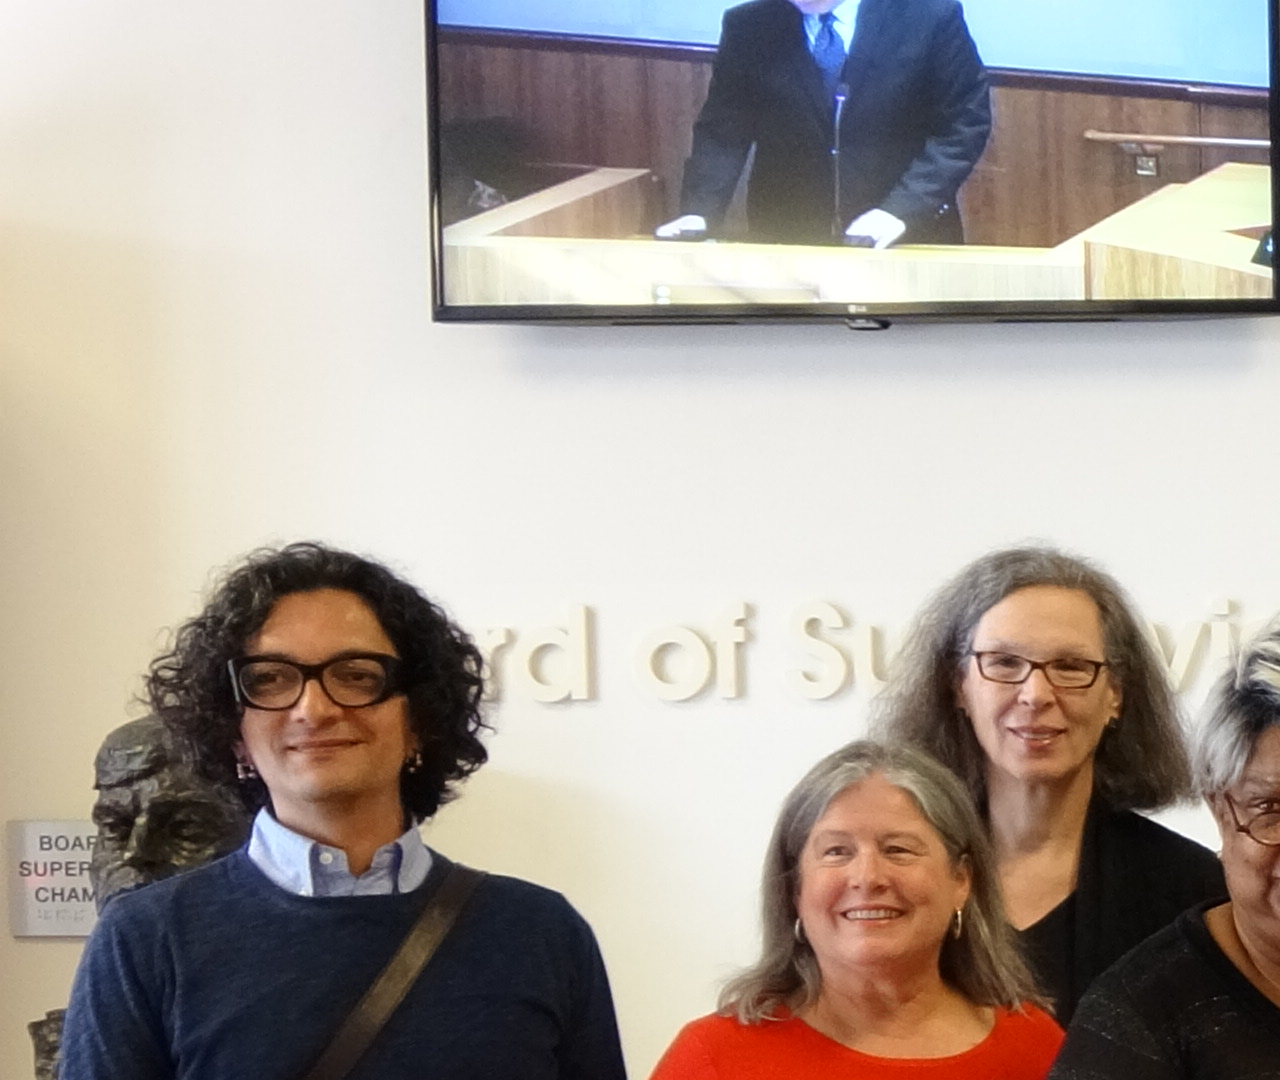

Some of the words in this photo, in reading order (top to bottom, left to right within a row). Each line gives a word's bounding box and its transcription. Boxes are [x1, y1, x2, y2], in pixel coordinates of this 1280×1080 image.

[635, 601, 757, 702] of
[39, 835, 98, 851] BOAR
[18, 861, 92, 877] SUPER
[34, 887, 98, 903] CHAM
